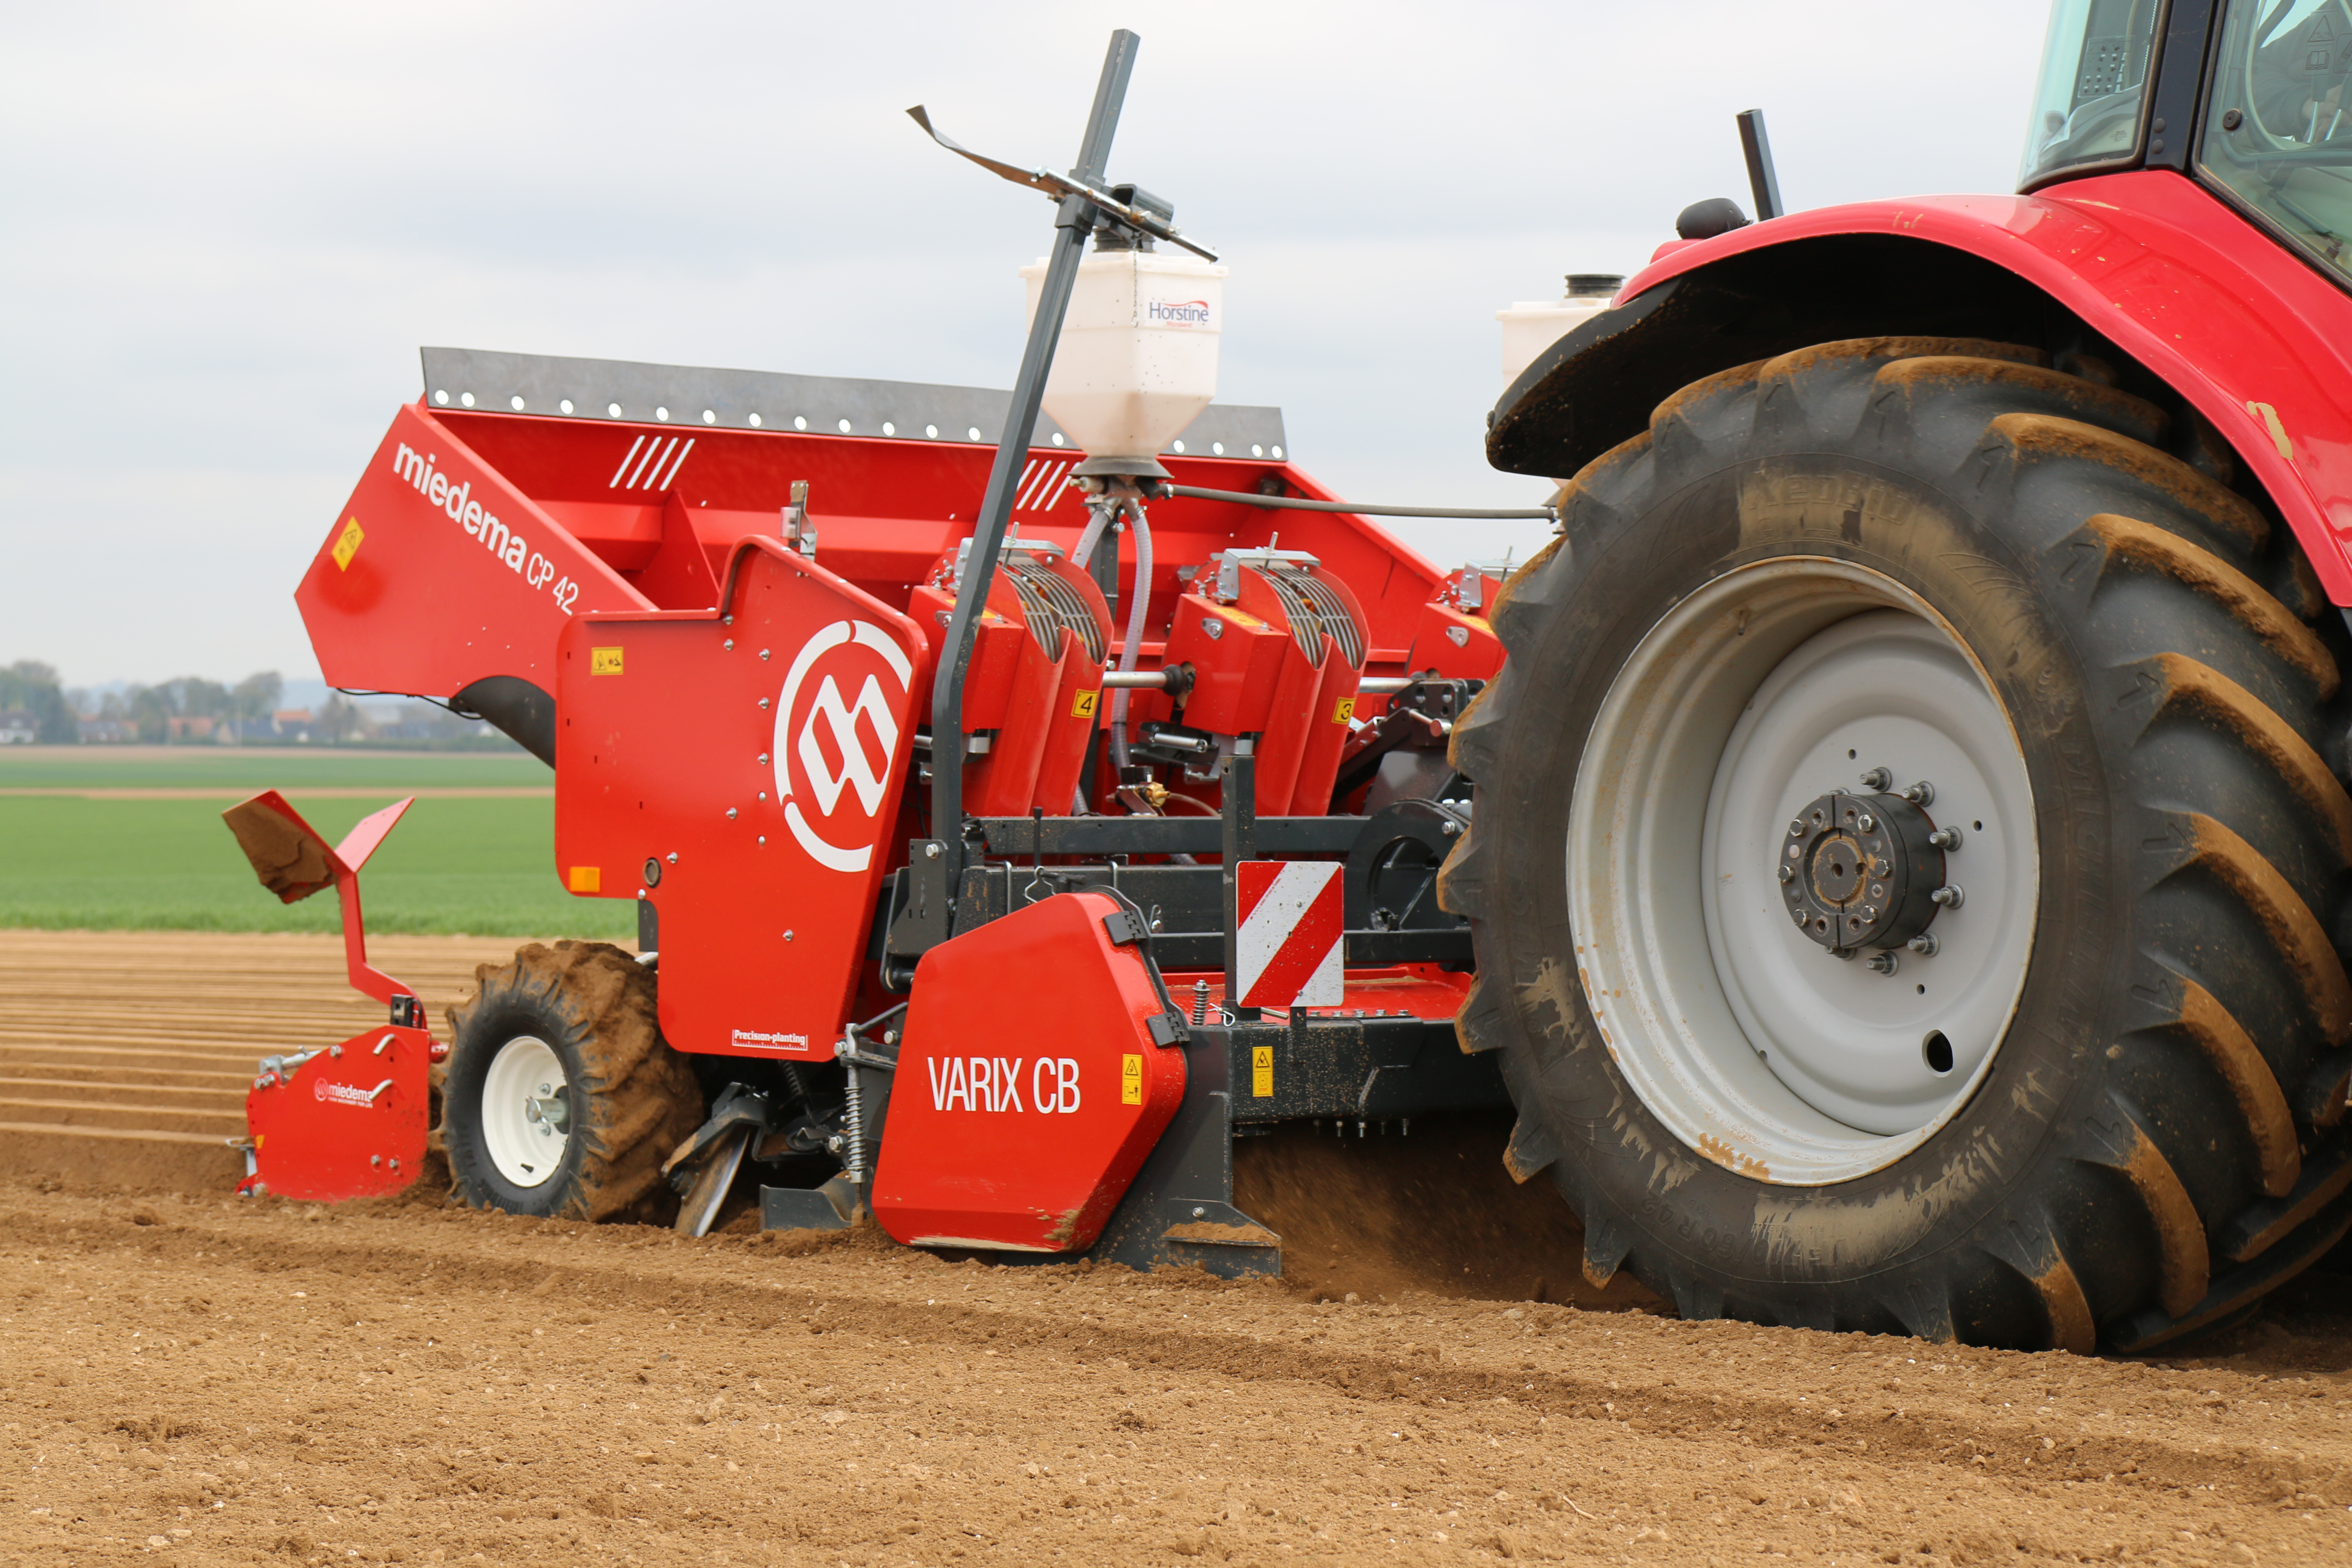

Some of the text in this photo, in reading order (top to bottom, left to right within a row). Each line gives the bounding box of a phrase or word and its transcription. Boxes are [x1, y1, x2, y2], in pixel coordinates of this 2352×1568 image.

[1149, 302, 1209, 322] Horstine
[393, 442, 579, 616] miedema CP 42
[1080, 695, 1093, 714] 4
[1341, 703, 1352, 720] 3
[734, 1029, 805, 1046] Precision-planting
[927, 1057, 1081, 1114] VARIX CB
